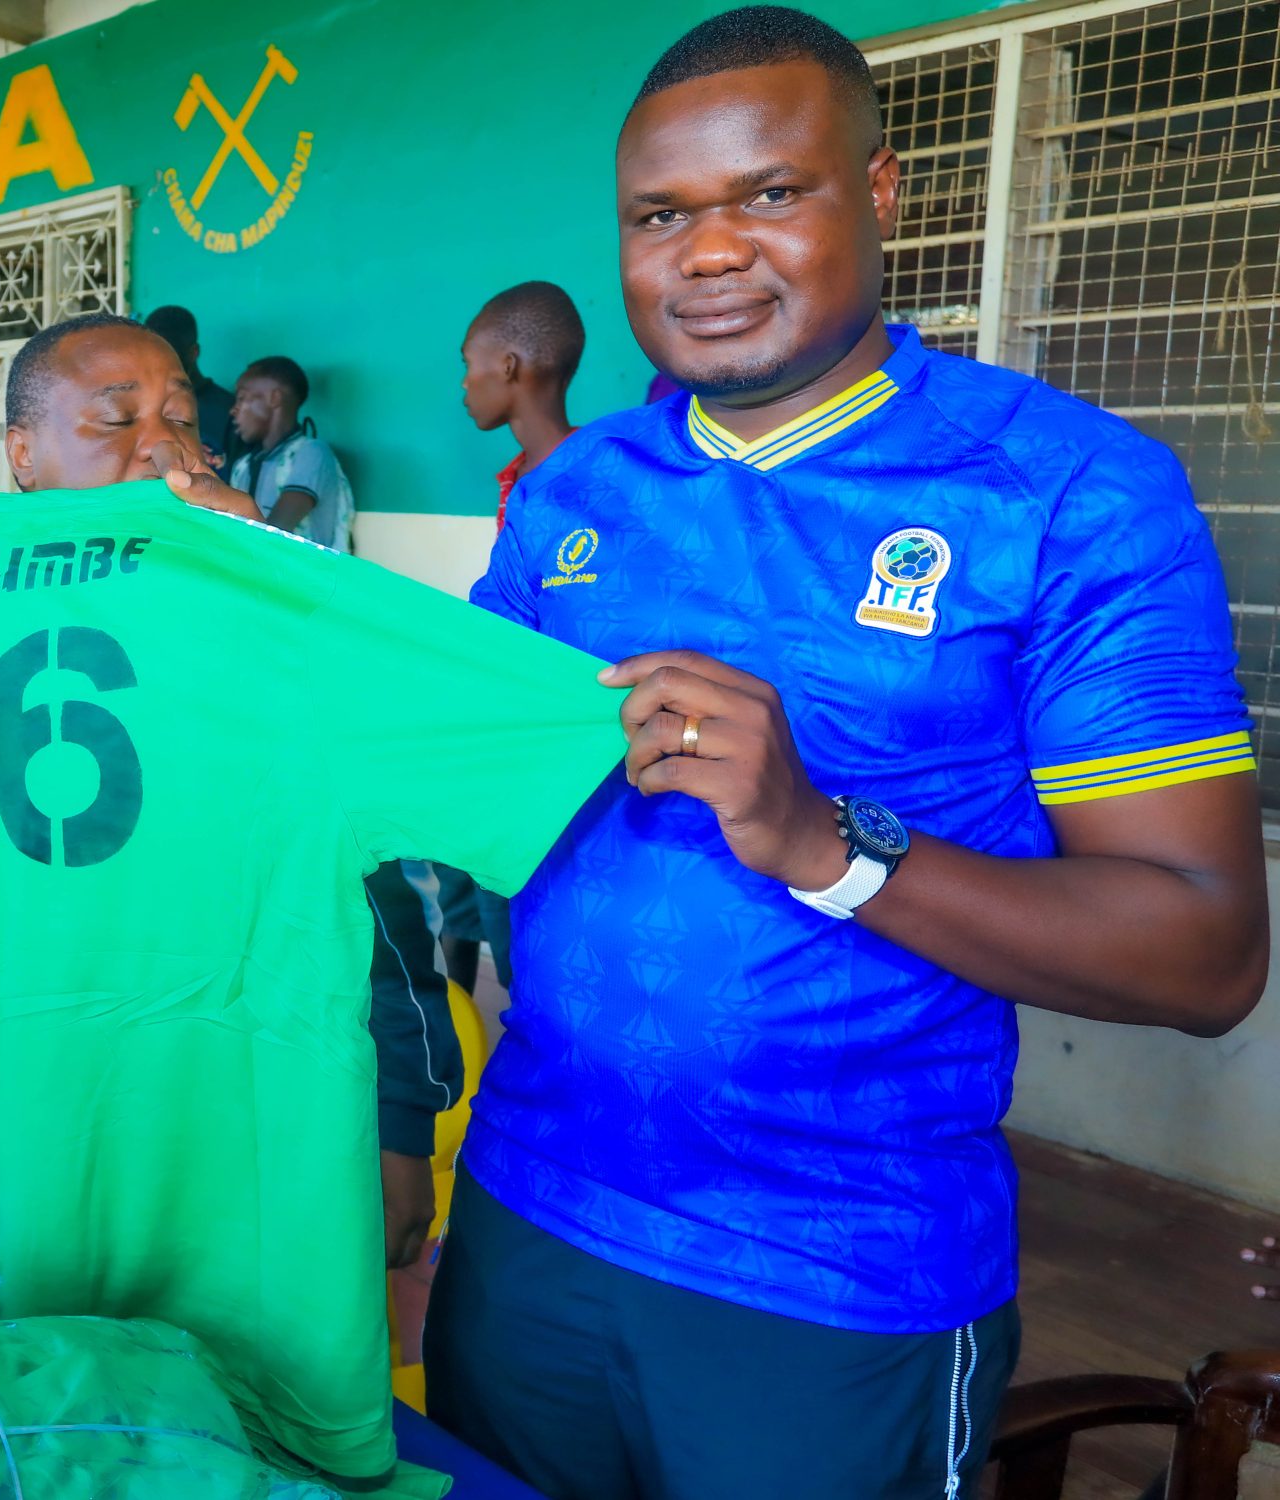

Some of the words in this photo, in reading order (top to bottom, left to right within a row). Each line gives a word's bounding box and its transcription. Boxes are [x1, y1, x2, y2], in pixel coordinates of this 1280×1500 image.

[163, 167, 203, 242] CHAMA
[204, 230, 238, 253] CHA
[241, 130, 314, 250] MAPINDUZI
